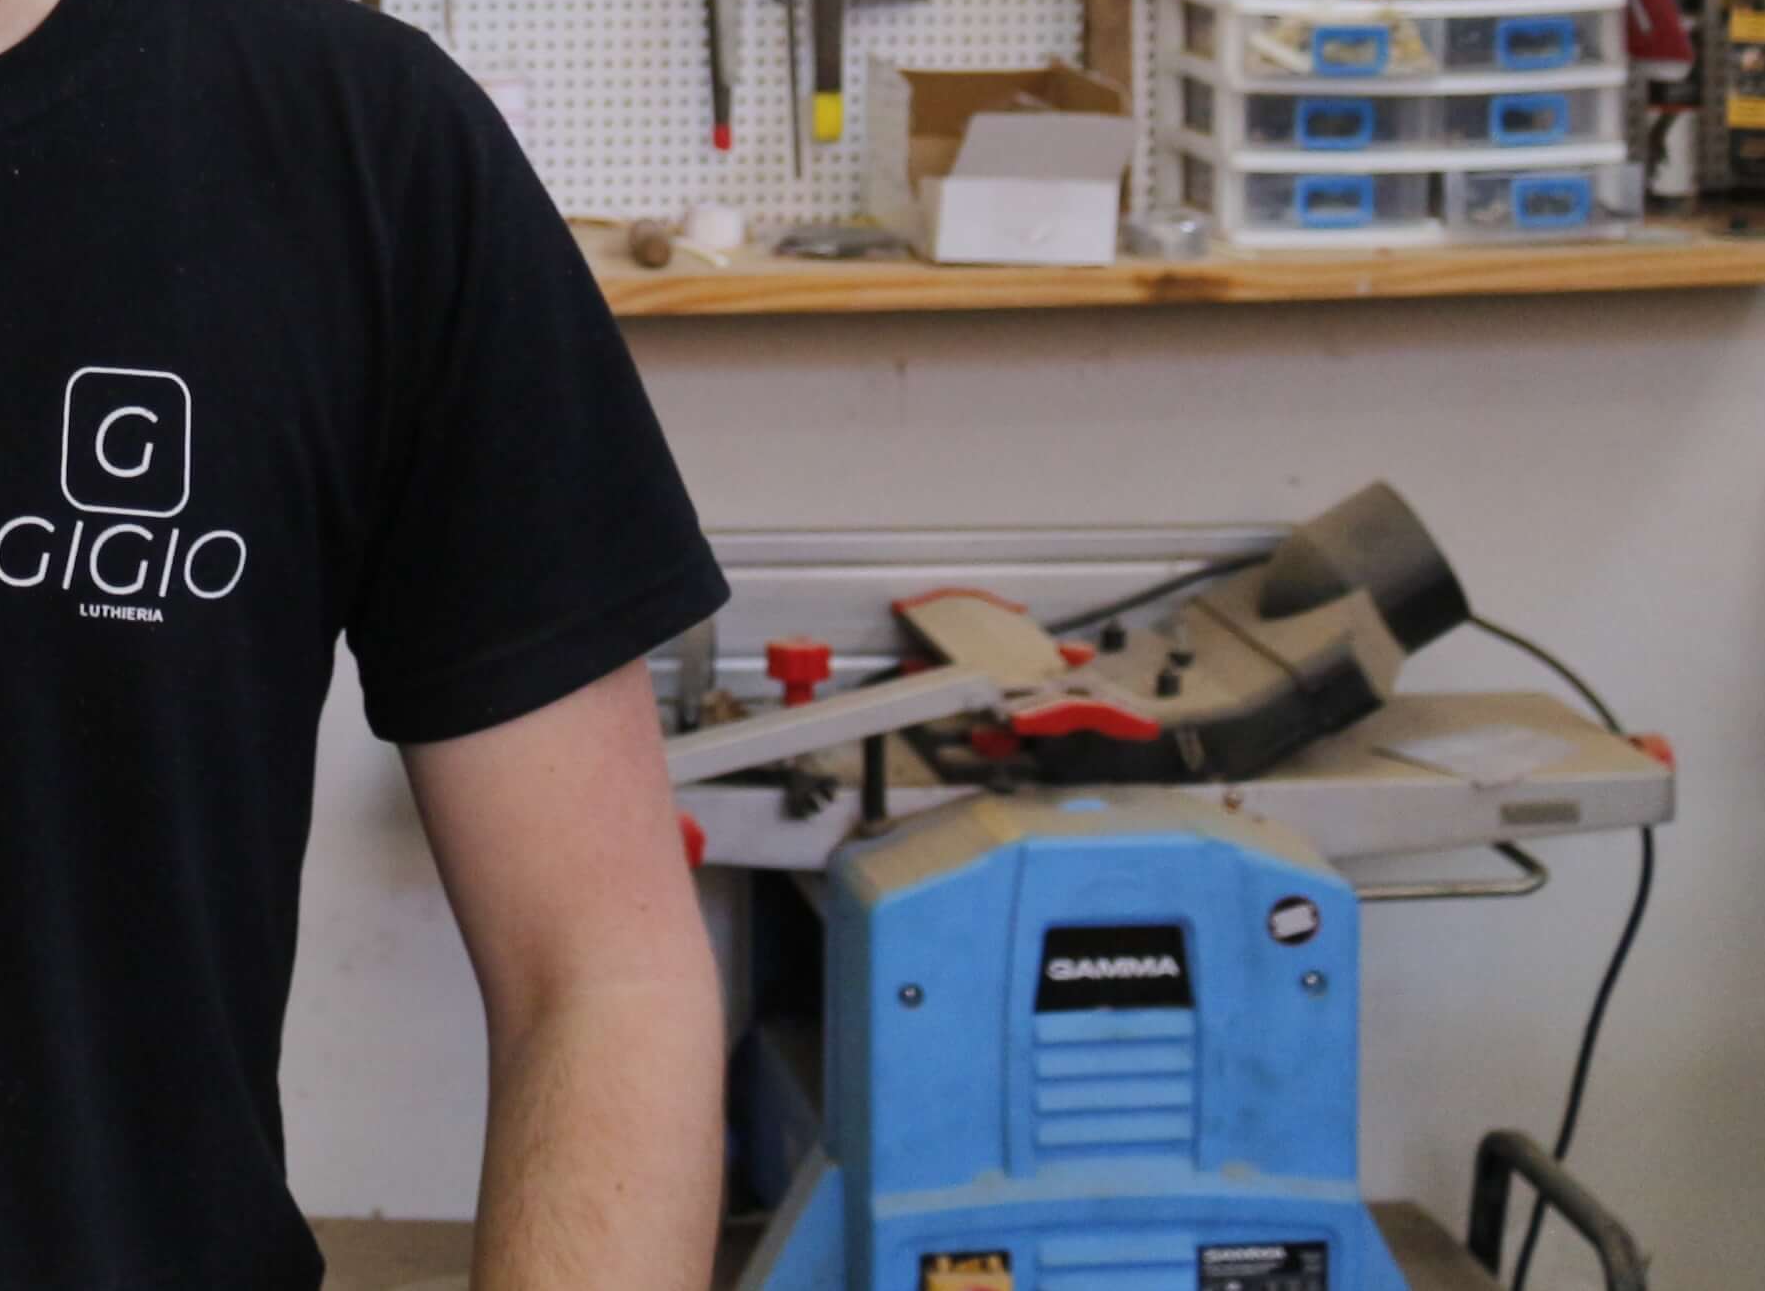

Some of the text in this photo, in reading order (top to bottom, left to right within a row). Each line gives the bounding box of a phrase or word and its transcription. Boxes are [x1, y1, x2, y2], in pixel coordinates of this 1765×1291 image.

[95, 405, 159, 478] G
[79, 603, 164, 623] LUTHIERIA
[1046, 955, 1180, 981] GAMMA
